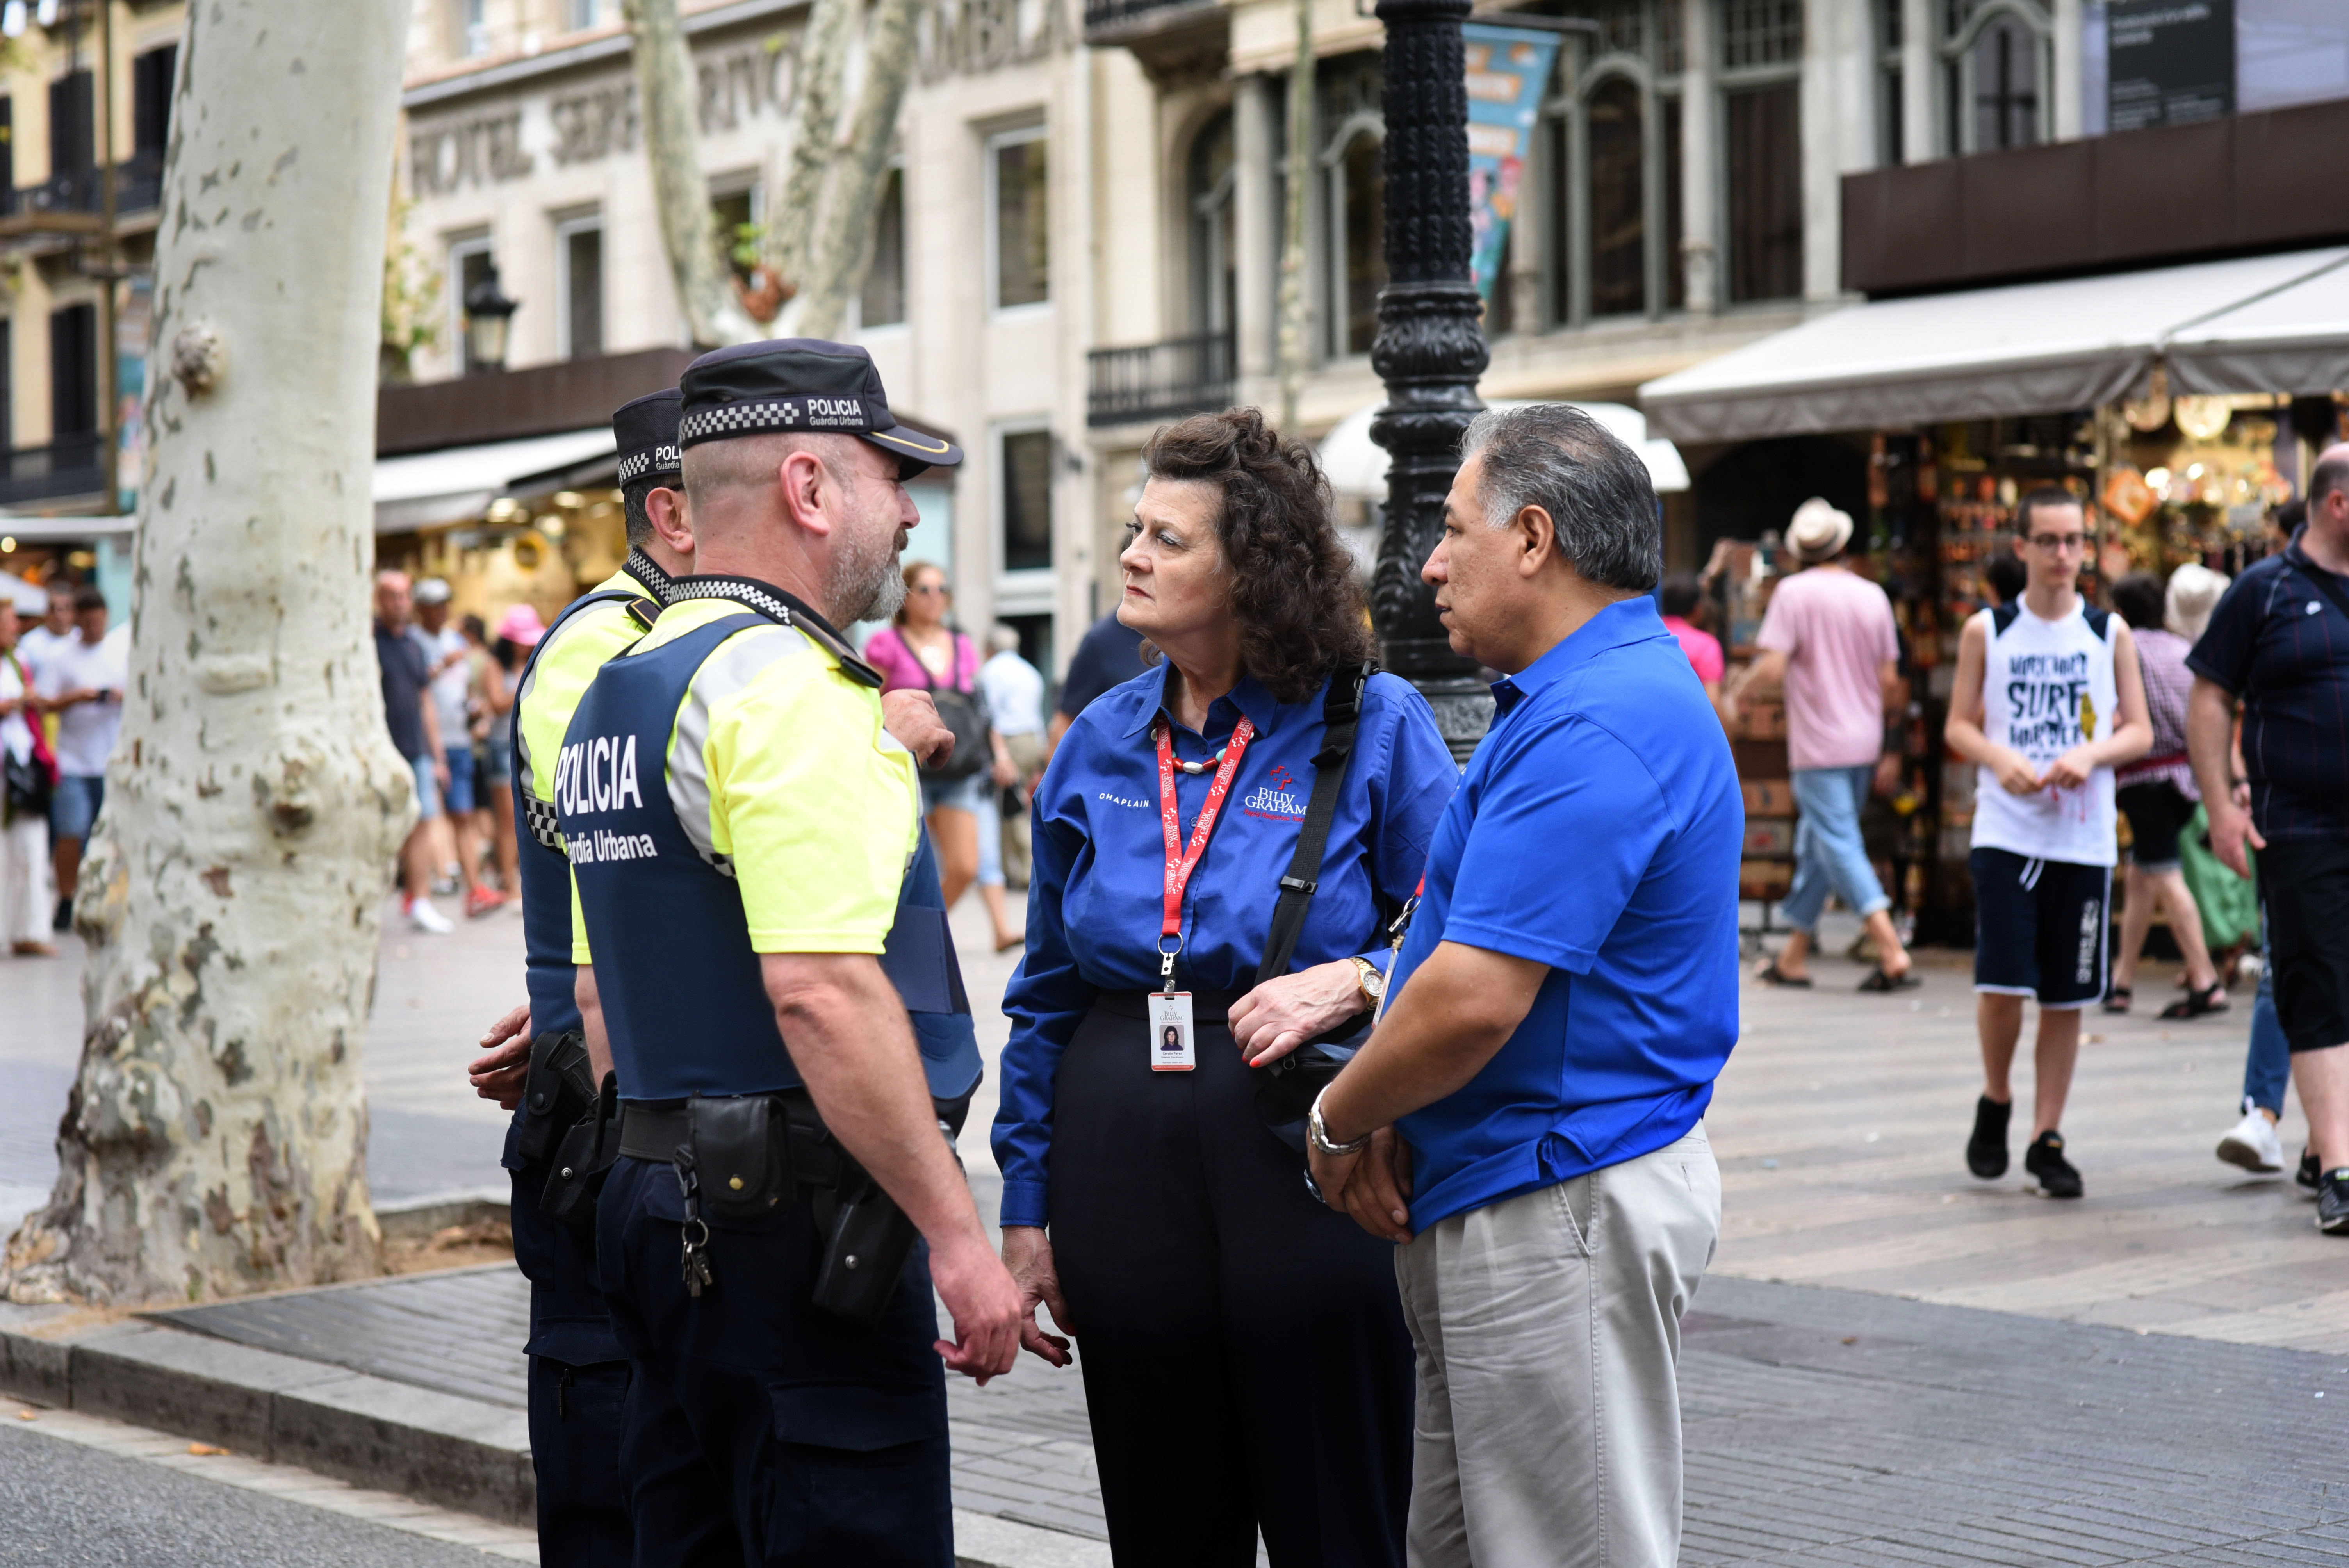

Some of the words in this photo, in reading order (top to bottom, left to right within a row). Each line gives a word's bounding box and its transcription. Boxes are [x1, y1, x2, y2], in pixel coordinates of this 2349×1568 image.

[807, 399, 862, 415] POLICIA
[809, 416, 838, 426] Guàrdia
[839, 416, 863, 425] Urbana
[656, 461, 680, 470] Guàrdia
[2008, 680, 2087, 719] SURF
[554, 735, 643, 817] POLICIA
[1220, 759, 1234, 784] GRAHAM
[1099, 793, 1149, 807] CHAPLAIN
[1245, 795, 1307, 815] GRAHAM
[1259, 787, 1296, 808] BILLY
[1200, 808, 1214, 834] GRAHAM
[594, 829, 658, 862] Urbana
